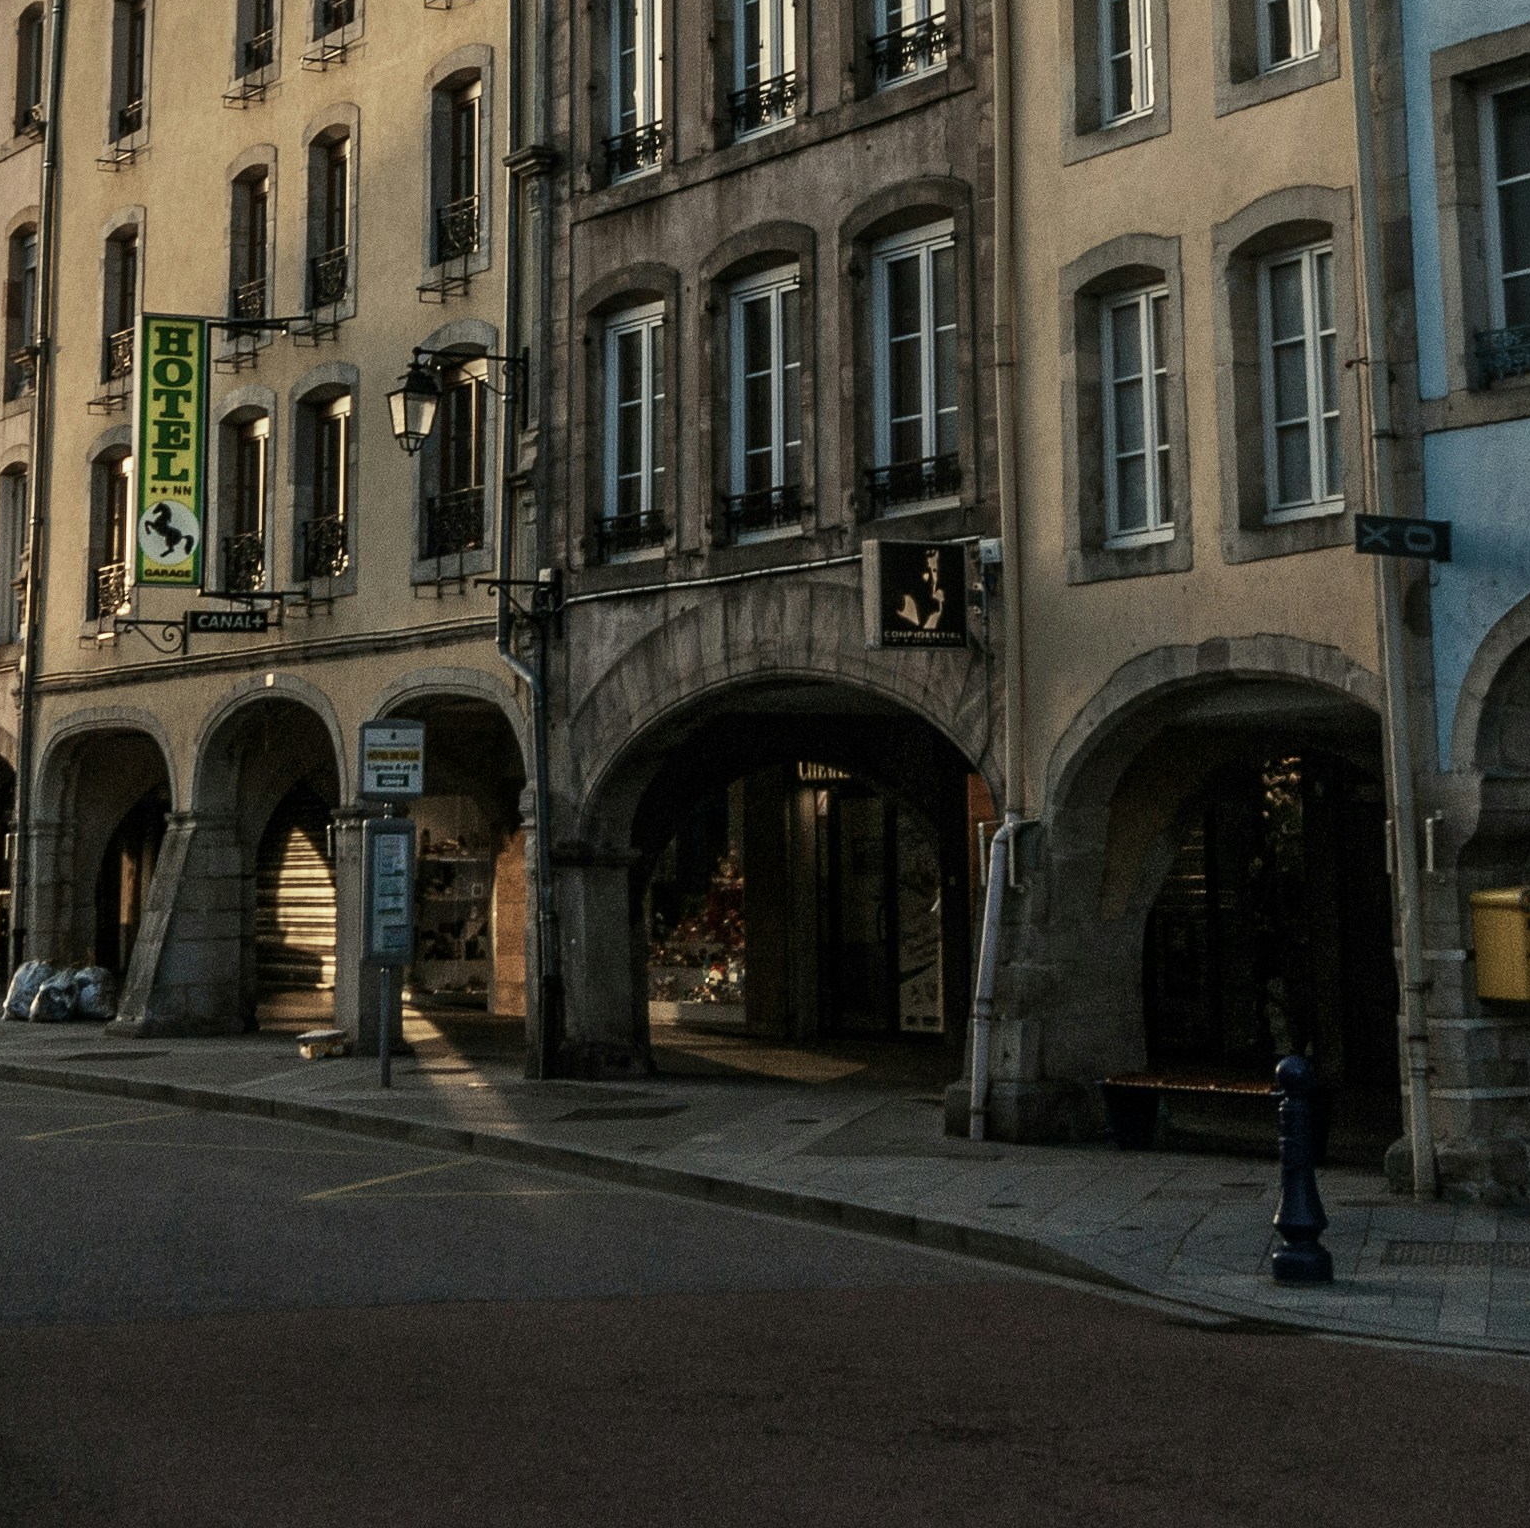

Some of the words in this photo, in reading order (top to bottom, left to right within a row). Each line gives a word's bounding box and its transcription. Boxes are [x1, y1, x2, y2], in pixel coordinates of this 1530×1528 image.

[151, 326, 194, 482] HOTEL
[144, 568, 191, 578] GARAGE
[196, 614, 265, 629] CANAL+
